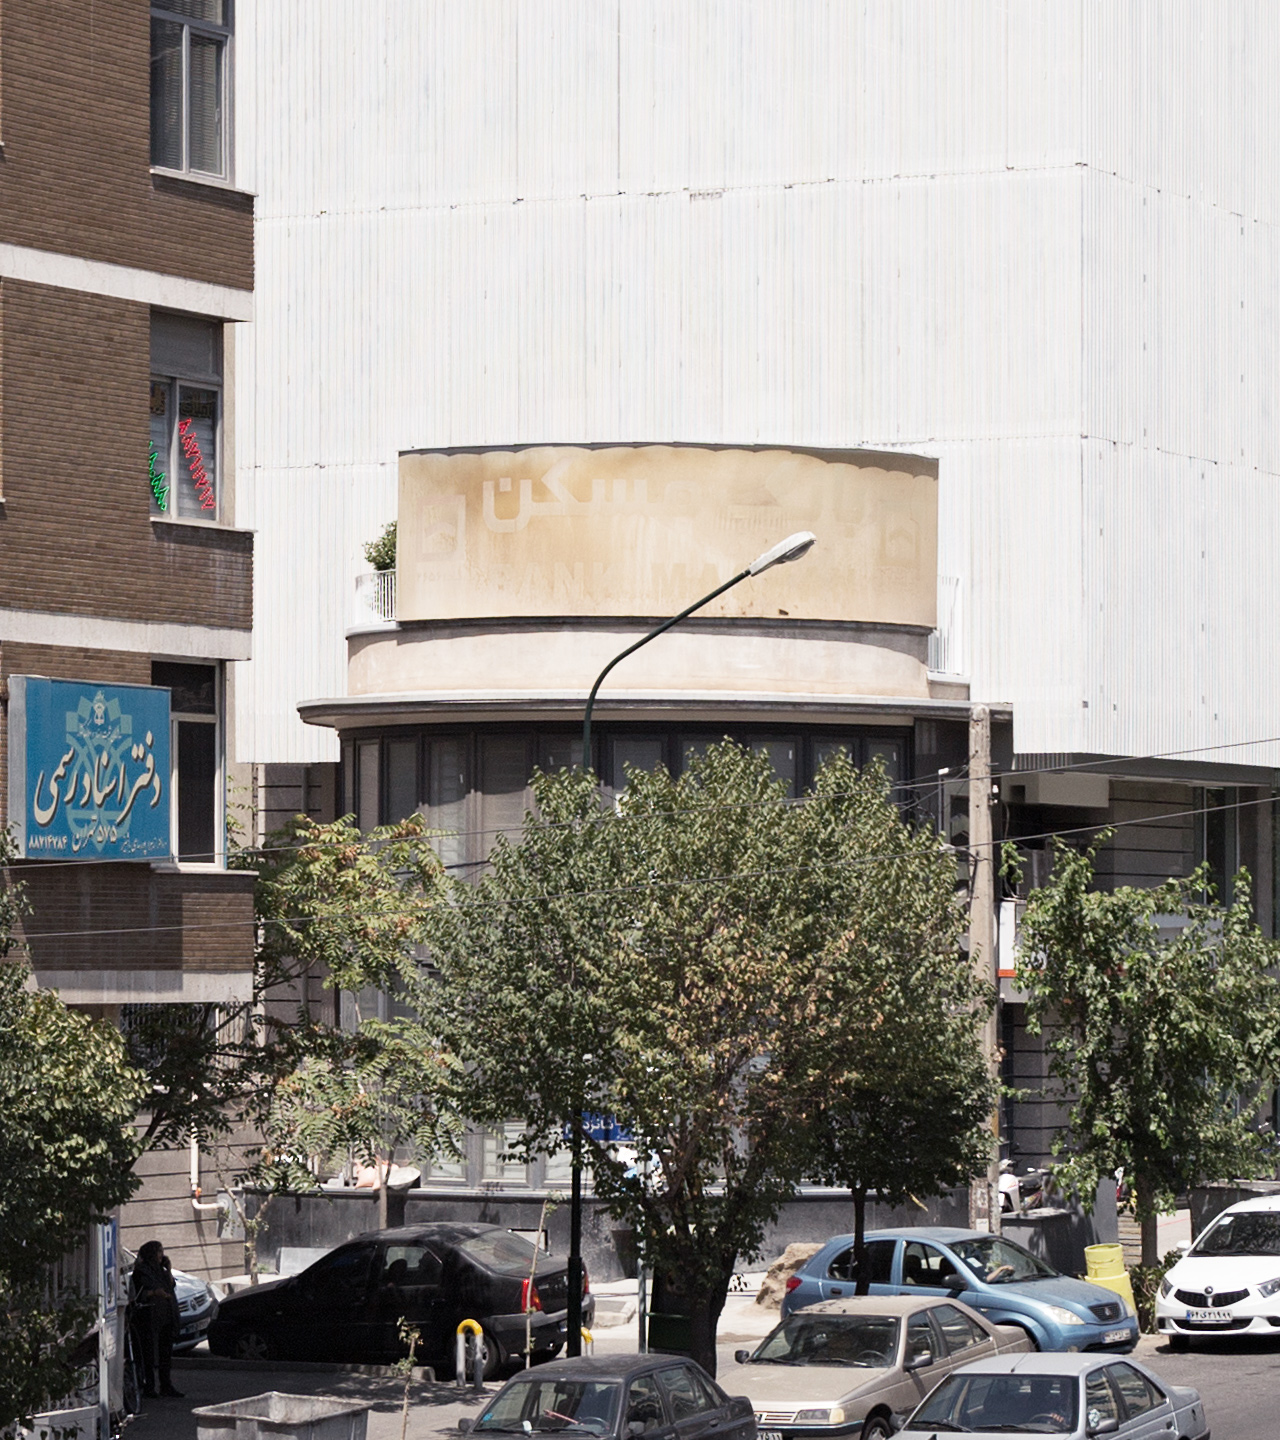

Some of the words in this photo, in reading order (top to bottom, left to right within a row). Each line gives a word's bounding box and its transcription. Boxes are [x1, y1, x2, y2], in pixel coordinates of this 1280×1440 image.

[34, 746, 79, 825] رسمی
[80, 751, 125, 808] اسناد
[116, 731, 162, 824] دفتر
